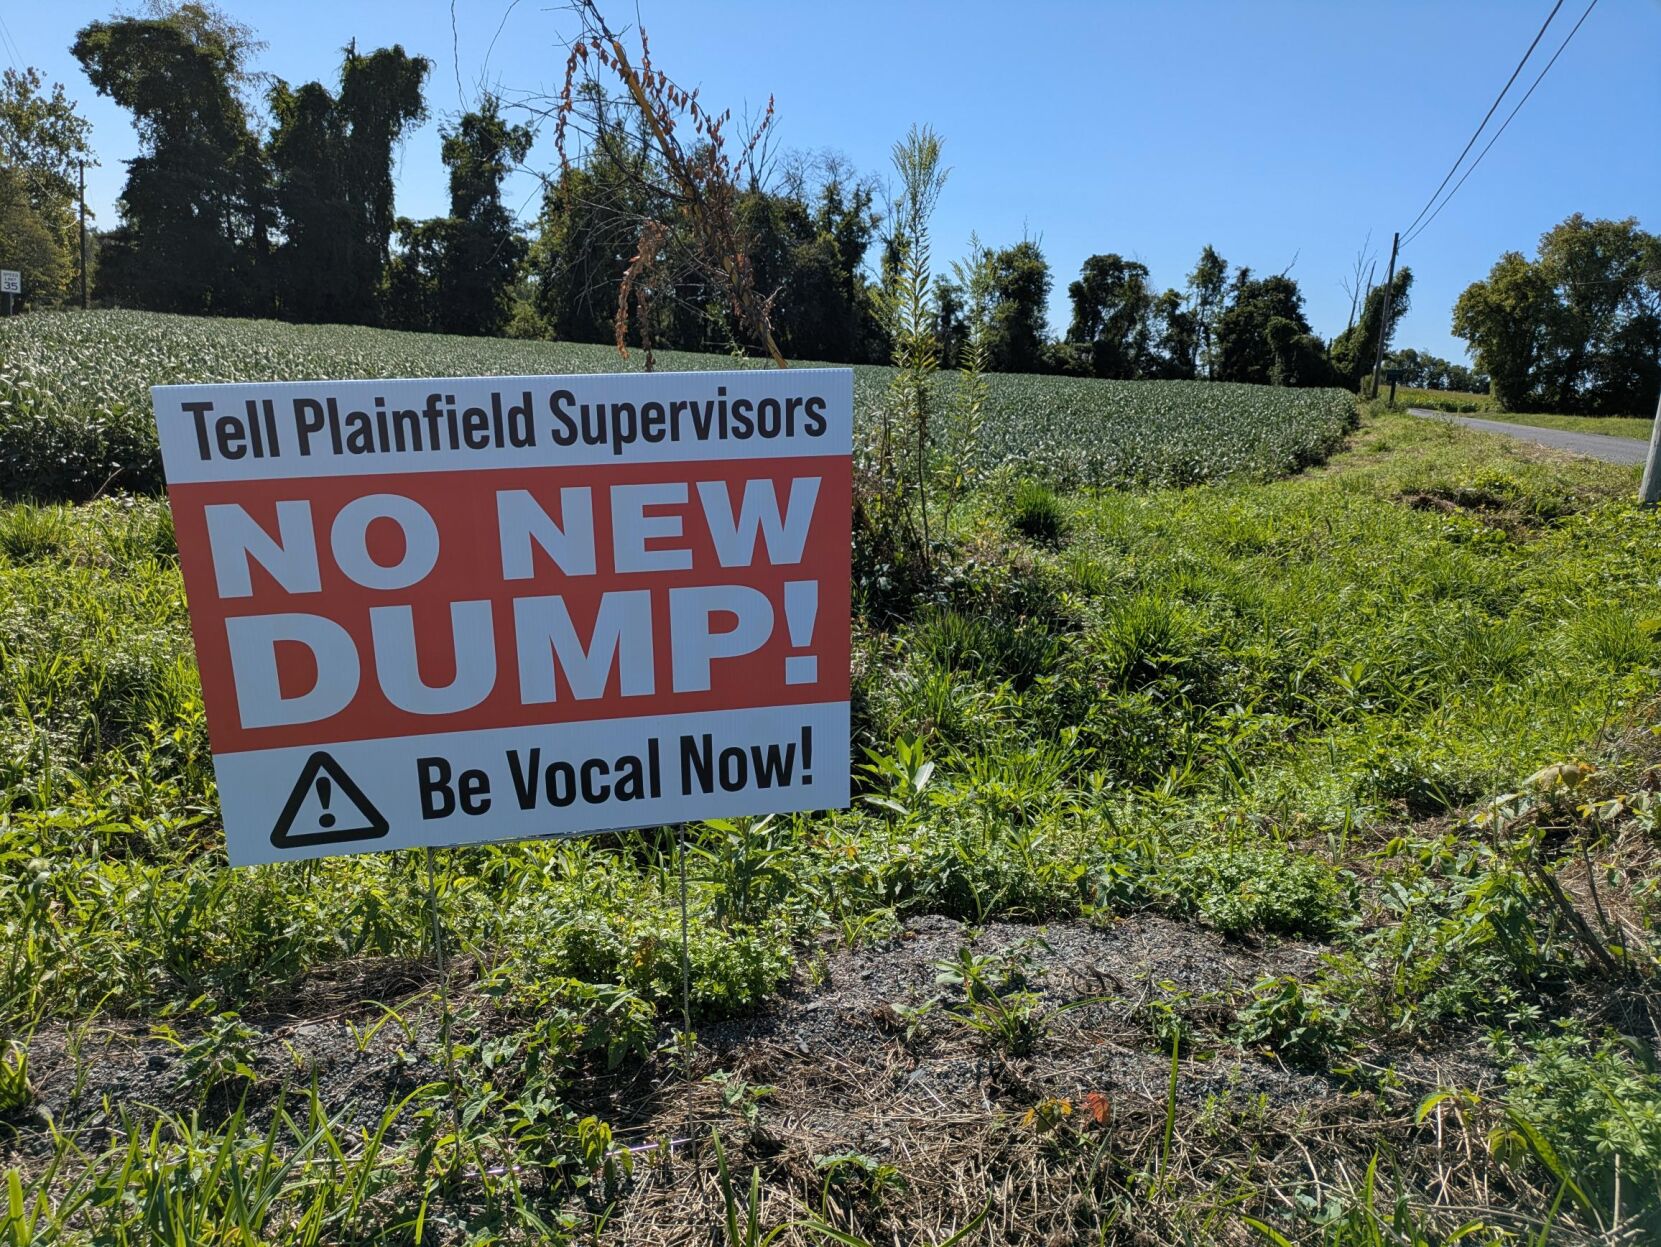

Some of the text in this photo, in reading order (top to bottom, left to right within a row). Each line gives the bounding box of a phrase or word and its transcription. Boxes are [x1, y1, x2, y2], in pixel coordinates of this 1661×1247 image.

[3, 281, 18, 291] 35
[181, 386, 828, 461] Tell Plainfield Supervisors
[203, 476, 823, 599] NO NEW
[224, 579, 820, 730] DUMP!
[416, 725, 814, 821] Be Vocal Now!
